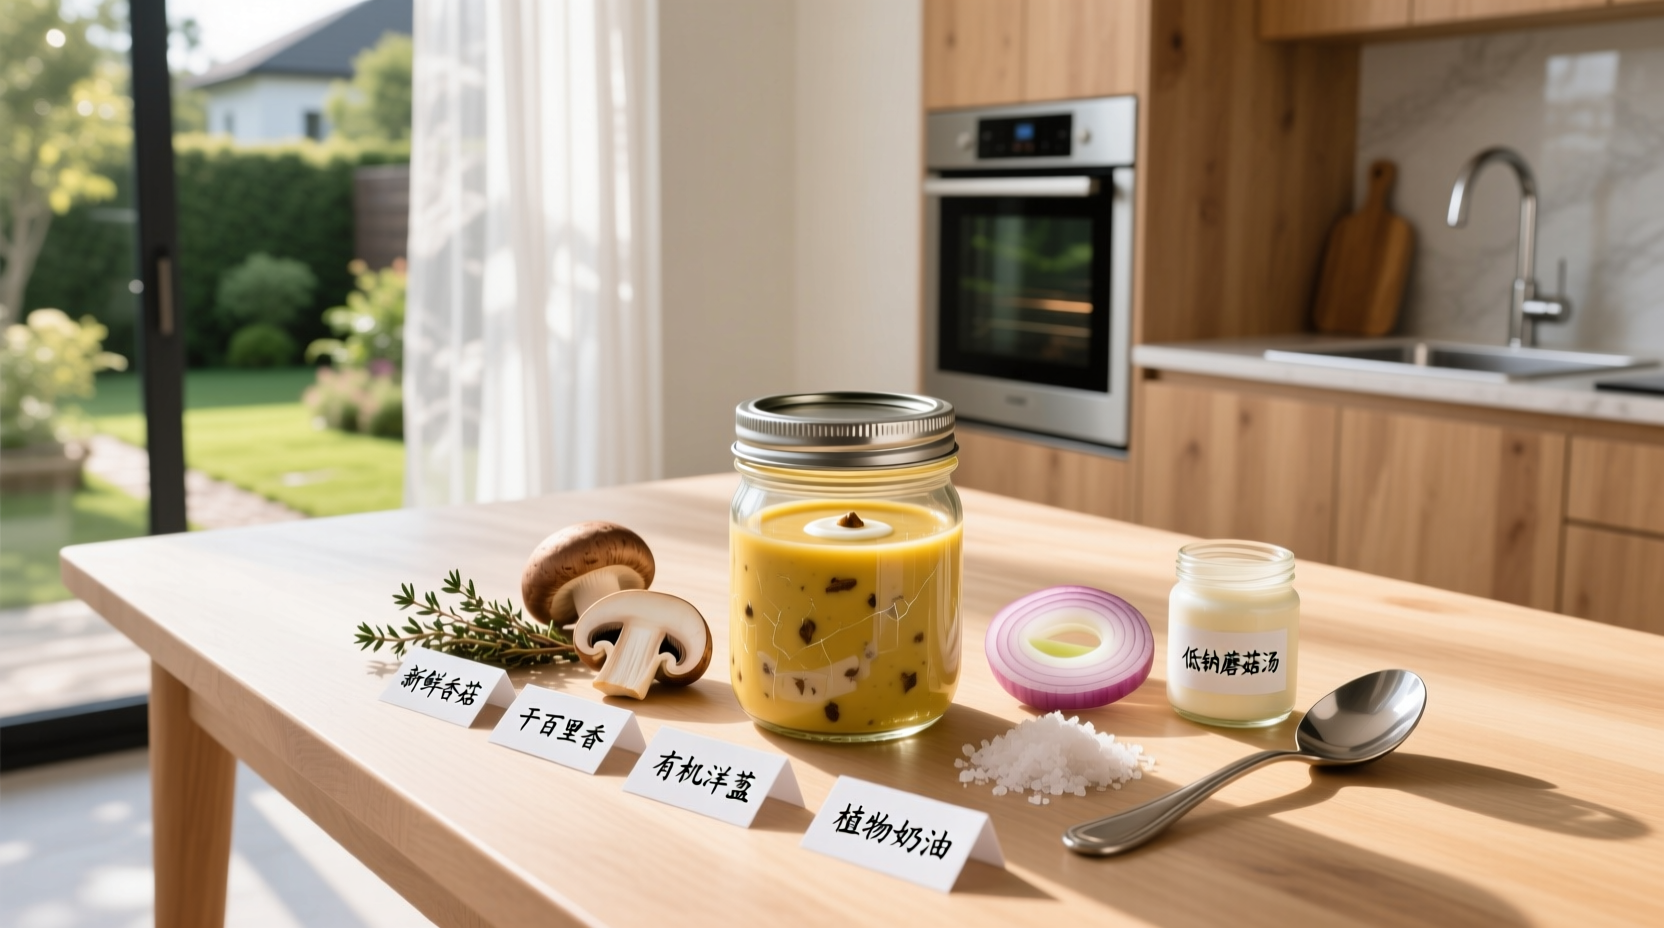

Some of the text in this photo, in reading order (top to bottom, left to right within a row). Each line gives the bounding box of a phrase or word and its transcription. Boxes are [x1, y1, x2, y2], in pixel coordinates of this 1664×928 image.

[1182, 646, 1279, 676] 低钠蘑菇汤
[401, 664, 482, 706] 新鲜香菇
[833, 803, 953, 860] 植物奶油
